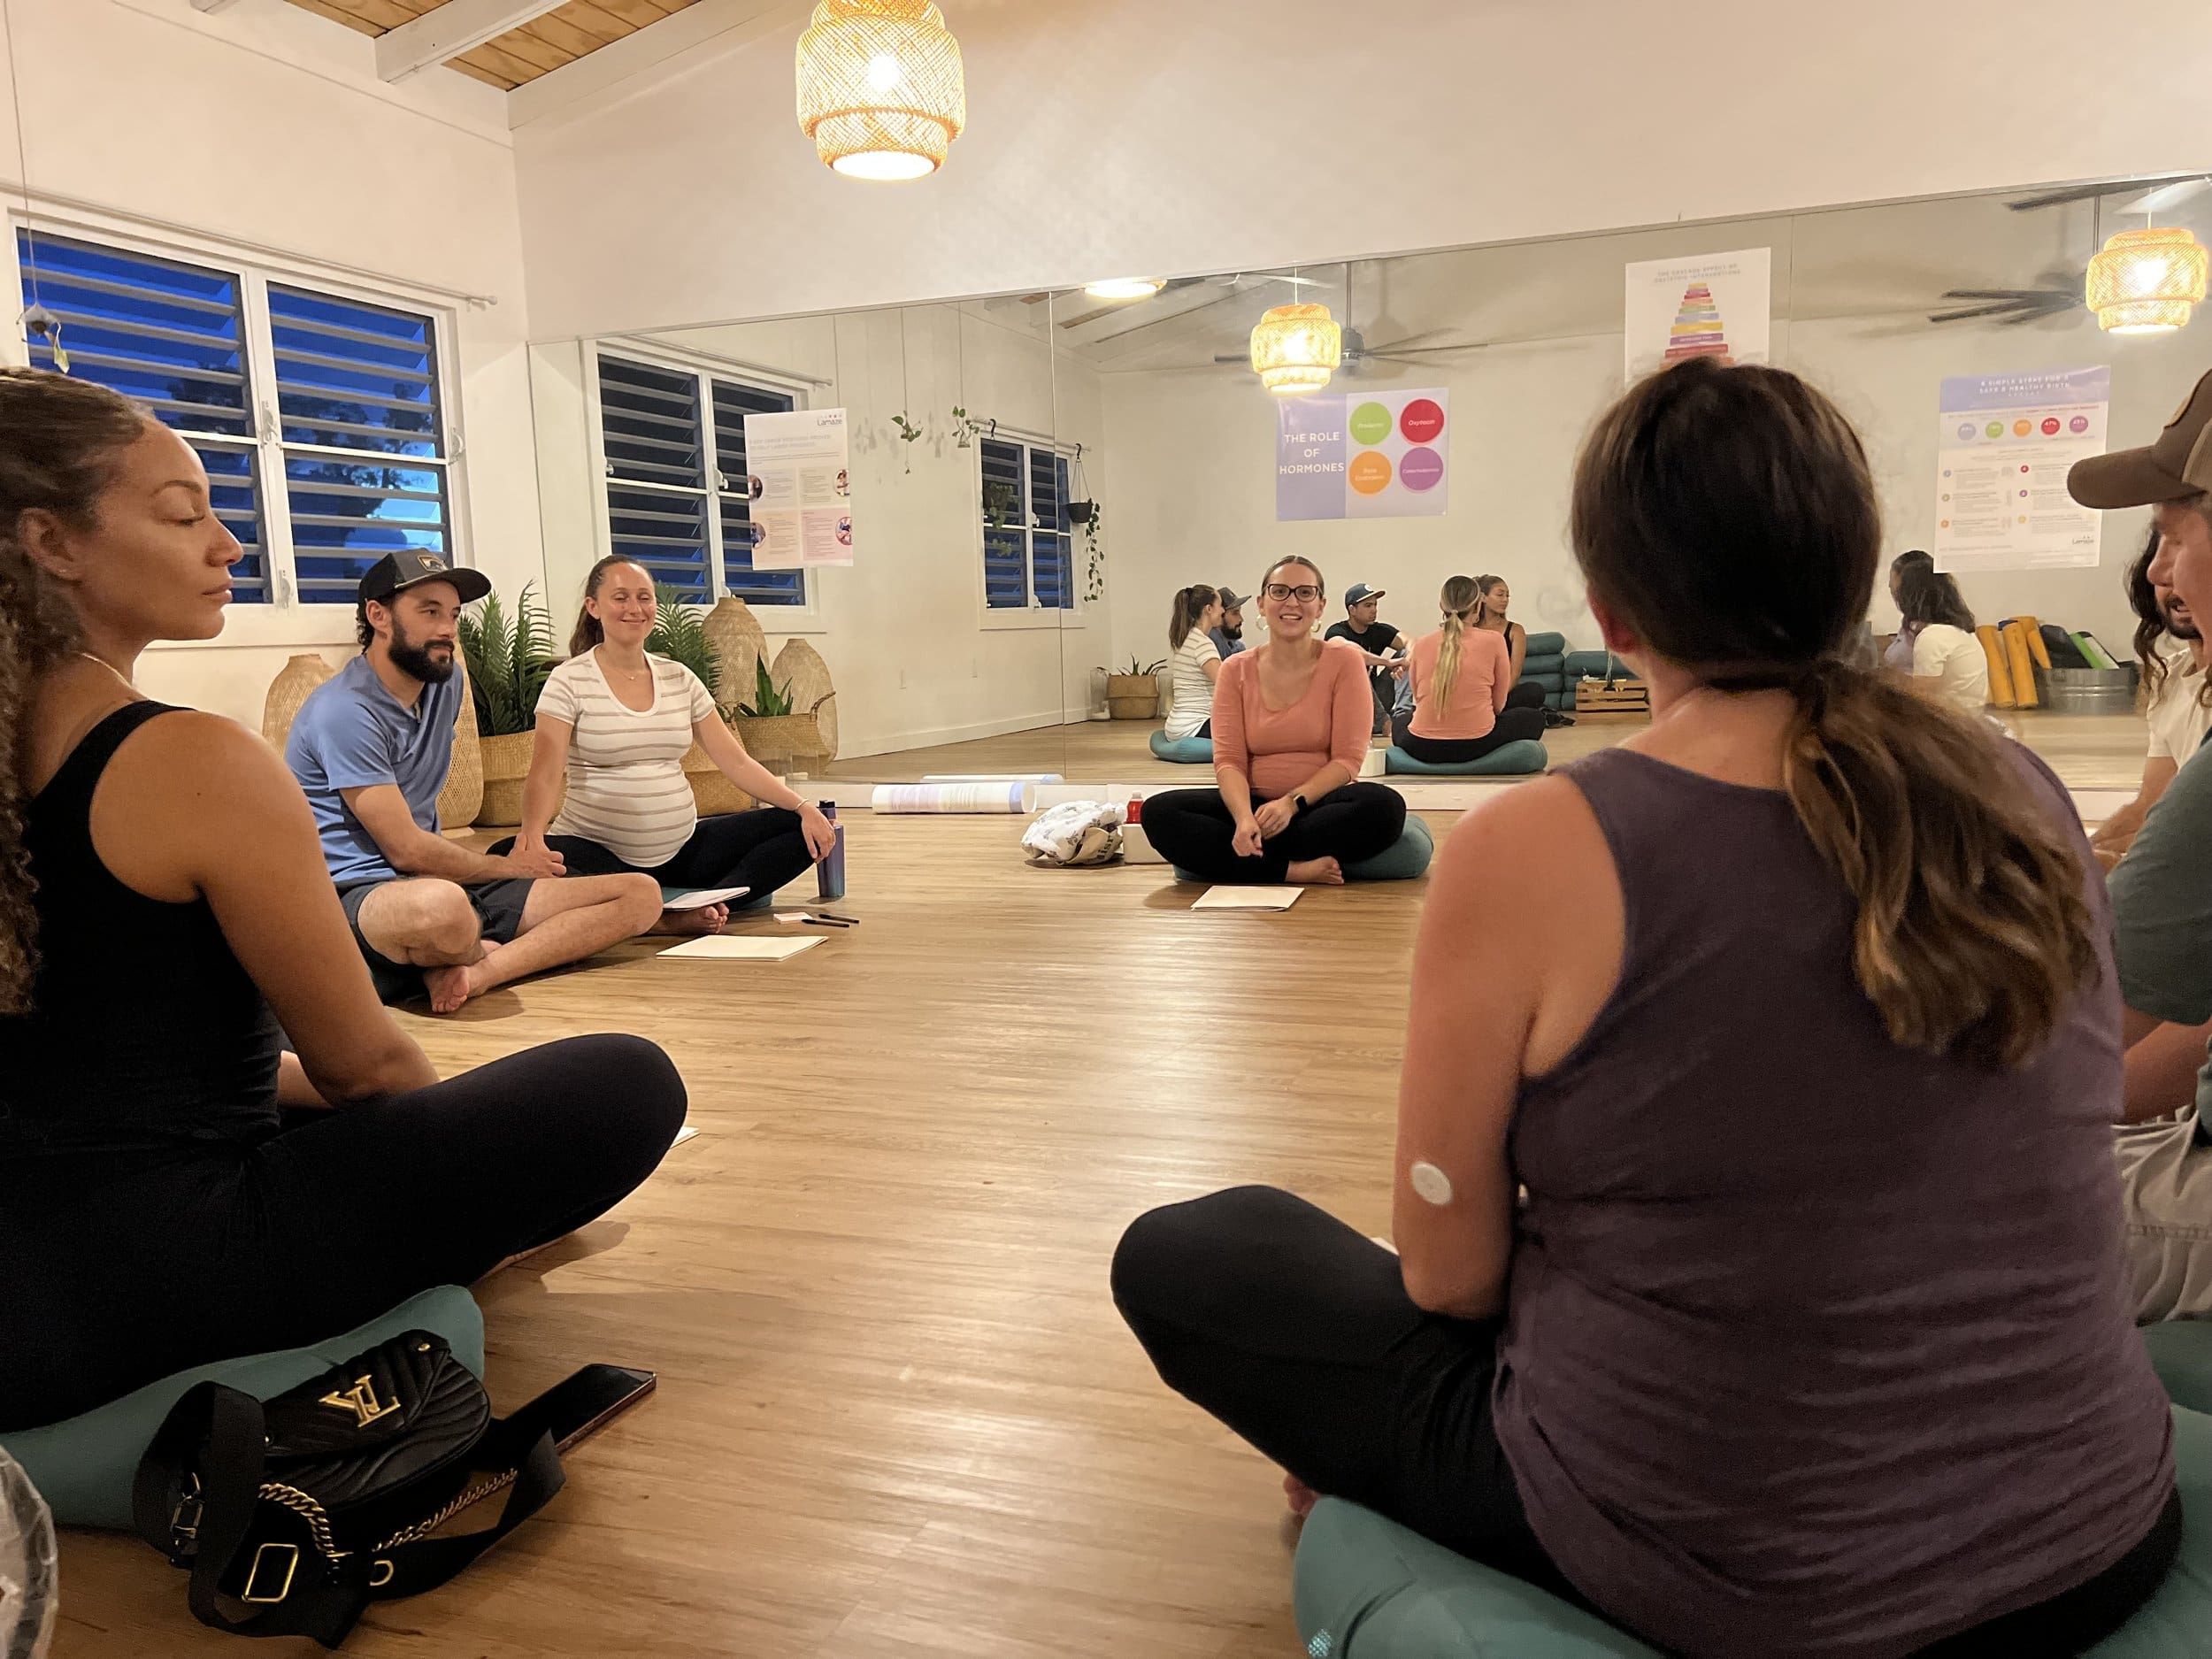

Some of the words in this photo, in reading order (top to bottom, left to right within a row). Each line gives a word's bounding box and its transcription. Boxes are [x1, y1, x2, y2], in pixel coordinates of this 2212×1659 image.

[1284, 434, 1306, 443] THE
[1310, 432, 1340, 442] ROLE
[1303, 449, 1320, 458] OF
[1279, 463, 1345, 475] HORMONES
